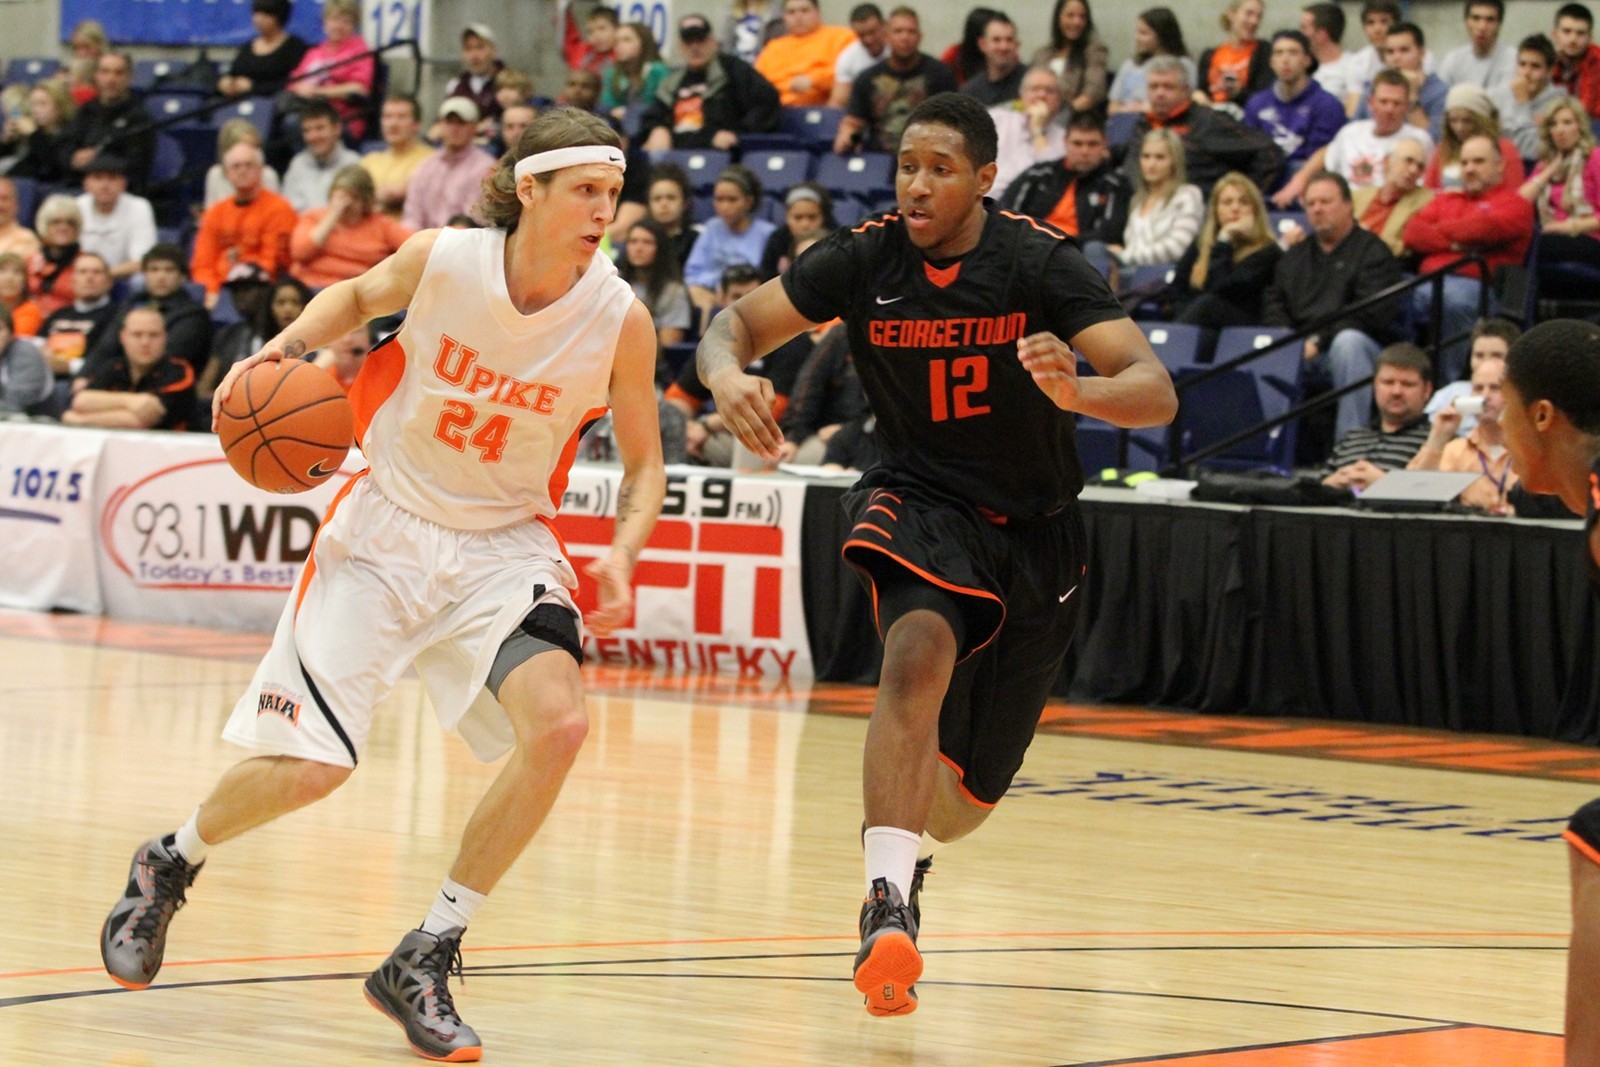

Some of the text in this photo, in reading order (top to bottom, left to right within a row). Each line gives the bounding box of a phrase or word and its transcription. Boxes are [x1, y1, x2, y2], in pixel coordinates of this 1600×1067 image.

[869, 312, 1027, 348] GEORGETOWN
[929, 355, 991, 423] 12
[433, 399, 514, 463] 24
[11, 467, 84, 502] 107.5
[562, 491, 589, 509] FM
[660, 475, 762, 519] 5.9 FM
[132, 502, 331, 563] 93.1 WD
[138, 563, 295, 585] Today's Best
[551, 513, 783, 639] PN
[257, 692, 296, 723] NAIA
